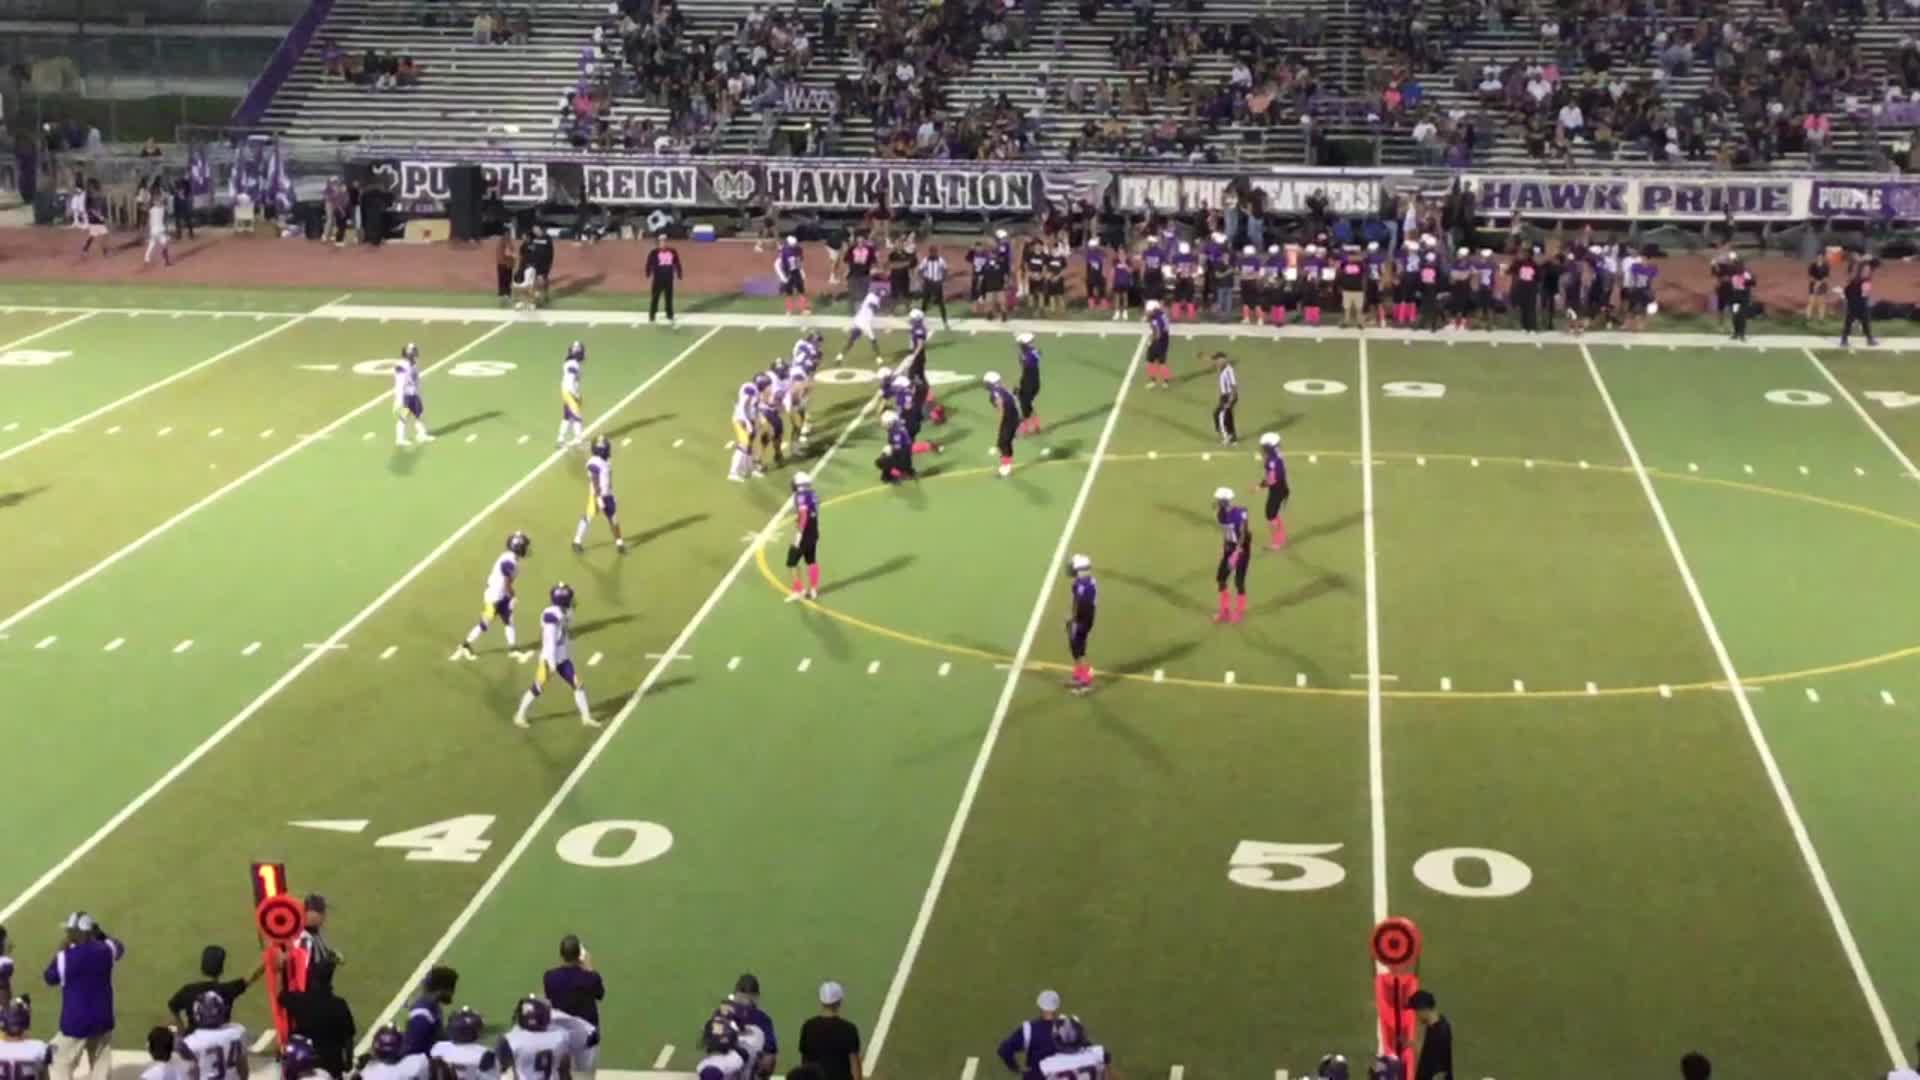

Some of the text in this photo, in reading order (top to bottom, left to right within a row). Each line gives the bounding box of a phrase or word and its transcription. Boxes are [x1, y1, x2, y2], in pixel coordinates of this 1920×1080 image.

[402, 163, 697, 203] PUPLE REIGN
[768, 169, 1032, 210] HAWK NATION
[1482, 182, 1790, 212] HAWK PRIDE
[259, 864, 277, 897] 1
